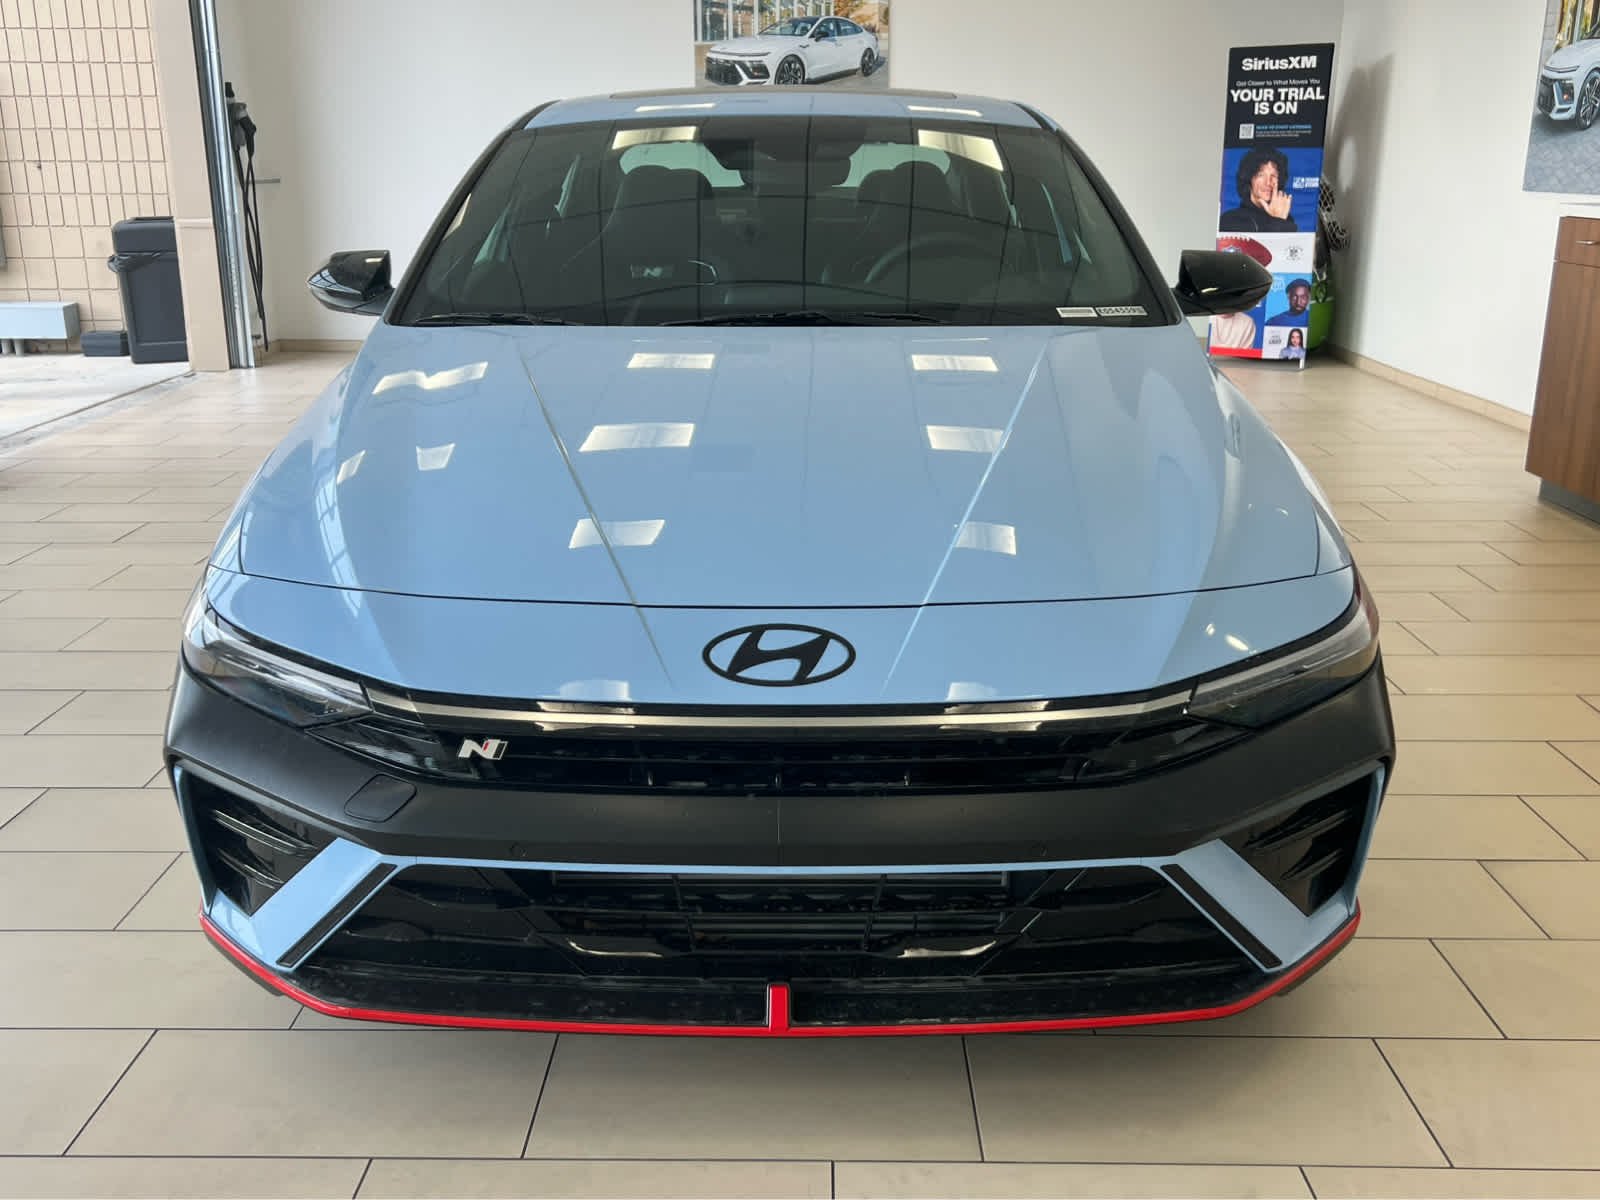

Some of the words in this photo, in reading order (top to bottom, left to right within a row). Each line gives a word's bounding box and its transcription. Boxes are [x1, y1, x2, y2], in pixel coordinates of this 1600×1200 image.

[1241, 55, 1317, 70] SiriusXM
[1230, 88, 1274, 102] YOUR
[1278, 86, 1325, 100] TRIAL
[1254, 101, 1270, 115] IS
[1272, 101, 1298, 115] ON
